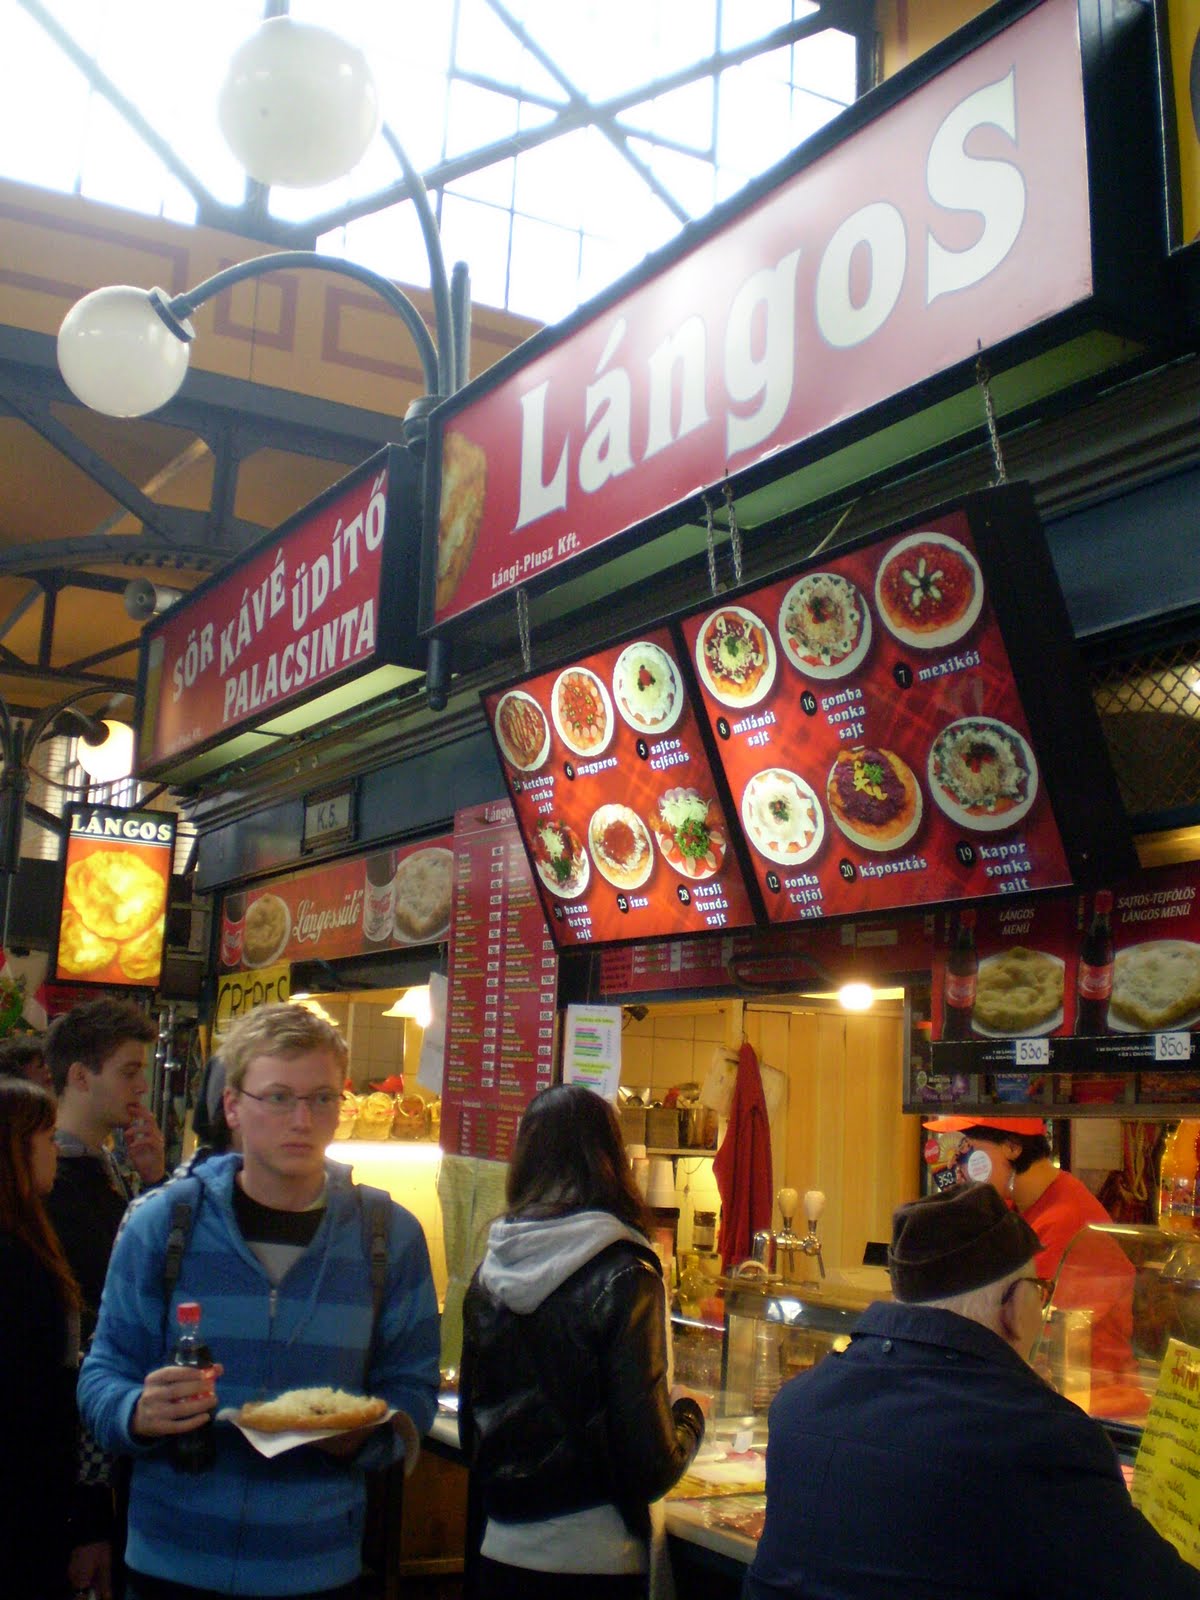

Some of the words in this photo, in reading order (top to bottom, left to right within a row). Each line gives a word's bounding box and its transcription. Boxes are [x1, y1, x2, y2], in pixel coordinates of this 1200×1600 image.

[492, 546, 554, 589] Lángi-Plusz
[558, 532, 580, 556] Kft.
[172, 622, 214, 702] SÖR
[219, 547, 286, 677] KÁVÉ
[292, 469, 387, 631] ÜDÍTŐ
[222, 598, 375, 723] PALACSINTA
[918, 651, 981, 681] mexikói
[898, 670, 905, 683] 7
[803, 696, 815, 711] 16
[821, 687, 863, 711] gomba
[732, 711, 776, 734] milánói
[827, 705, 866, 725] sonka
[719, 723, 727, 735] 8
[839, 722, 864, 739] sajt
[747, 731, 770, 746] sajt
[640, 743, 646, 756] 5
[650, 739, 681, 755] sajtos
[566, 766, 573, 776] 6
[577, 757, 618, 775] magyaros
[522, 775, 555, 790] ketchup
[531, 789, 554, 802] sonka
[538, 802, 554, 814] sajt
[70, 809, 172, 841] LÁNGOS
[960, 847, 973, 861] 19
[979, 843, 1026, 859] kapor
[841, 864, 853, 877] 20
[859, 855, 927, 877] káposztás
[986, 860, 1031, 876] sonka
[768, 876, 778, 888] 12
[784, 873, 819, 889] sonka
[1000, 878, 1029, 893] sajt
[679, 889, 690, 901] 28
[692, 883, 722, 897] virsli
[564, 904, 588, 915] bacon
[618, 898, 627, 909] 25
[629, 896, 648, 908] ízes
[695, 897, 729, 912] bunda
[800, 905, 823, 918] sajt
[706, 913, 727, 926] sajt
[576, 929, 592, 940] sajt
